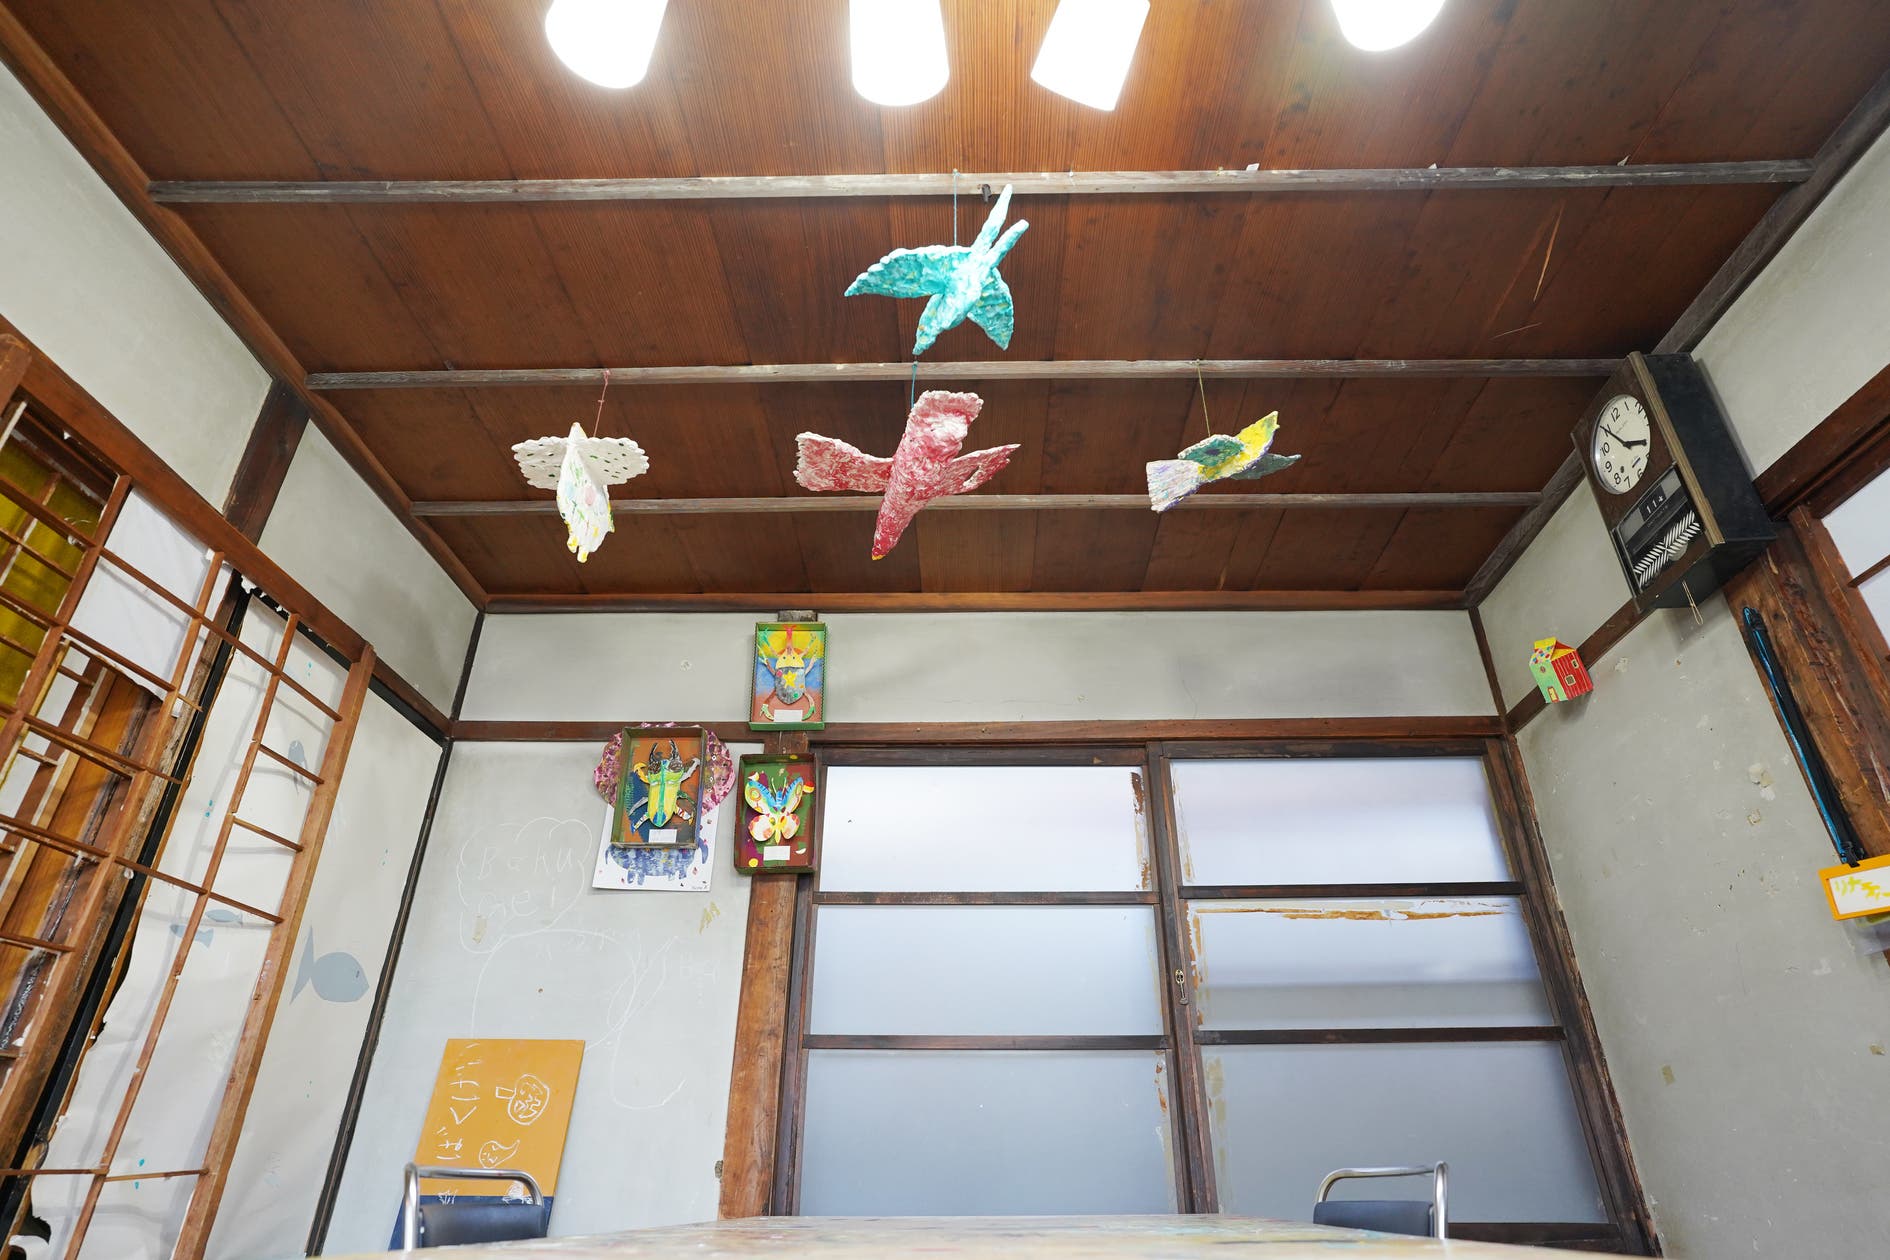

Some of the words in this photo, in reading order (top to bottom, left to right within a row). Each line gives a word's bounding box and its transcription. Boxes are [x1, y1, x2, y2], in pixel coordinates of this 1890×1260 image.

[1611, 407, 1620, 422] 12
[1601, 442, 1610, 456] 10
[1605, 461, 1612, 473] 9
[1613, 473, 1621, 485] 8
[1623, 476, 1631, 488] 7
